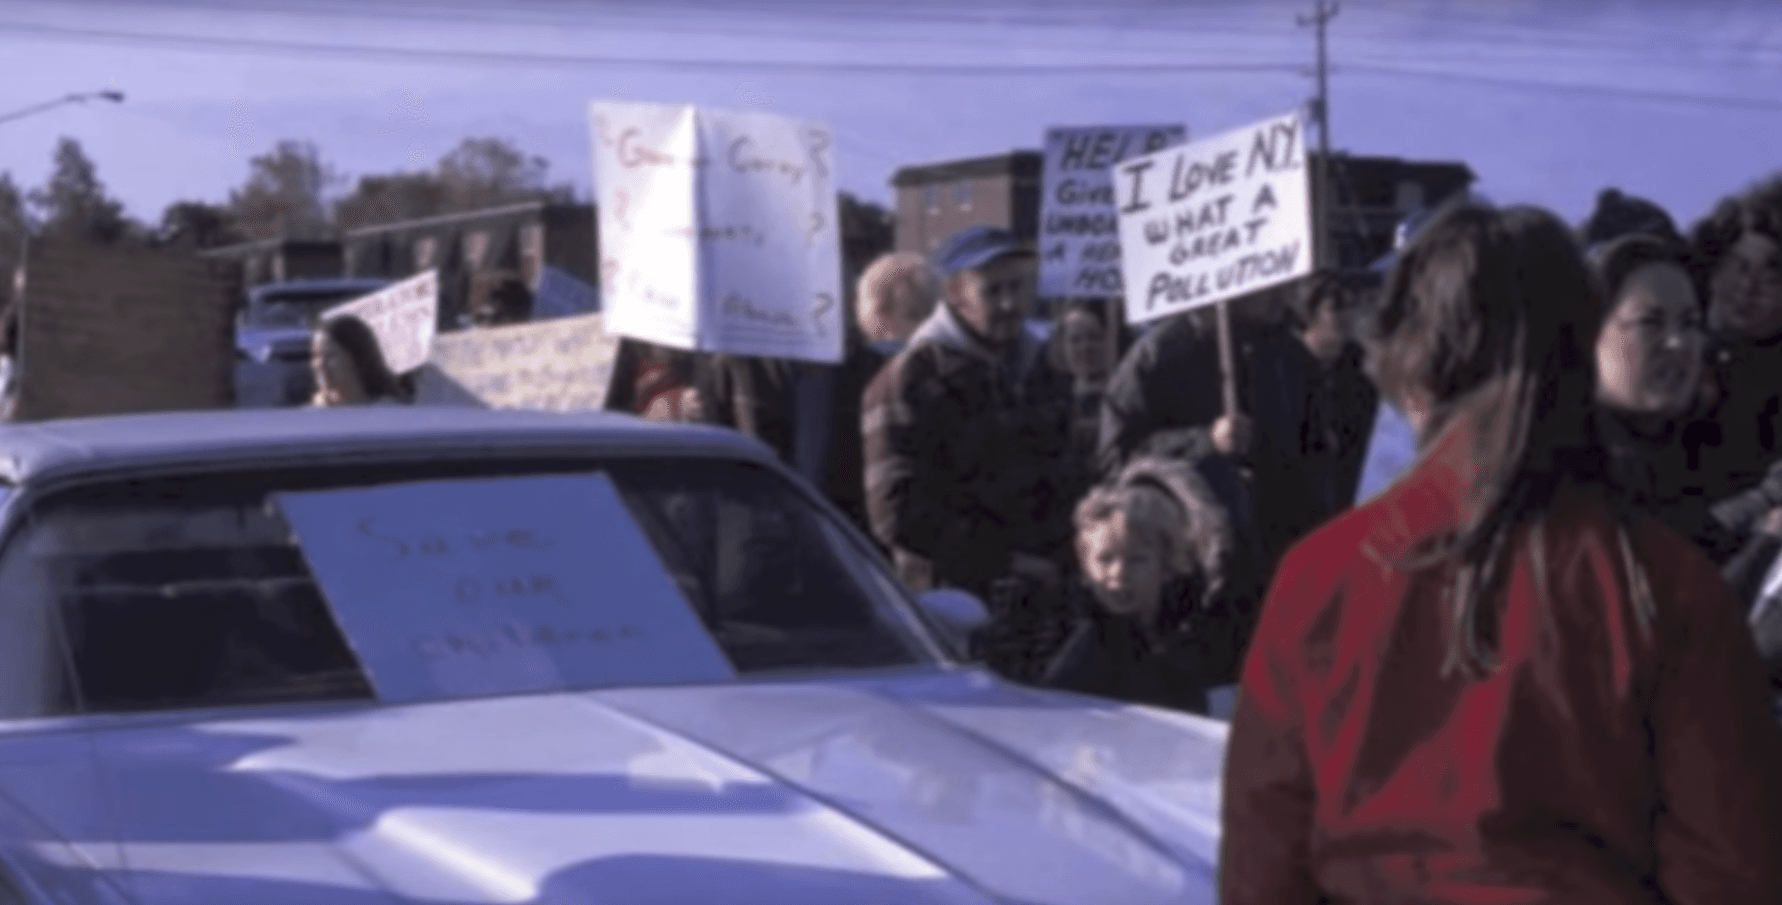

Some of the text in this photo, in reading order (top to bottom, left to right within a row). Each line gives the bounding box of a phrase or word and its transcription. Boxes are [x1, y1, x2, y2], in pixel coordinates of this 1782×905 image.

[1121, 160, 1154, 214] I
[1168, 149, 1238, 203] LOVE
[1143, 182, 1277, 246] WHAT A
[1168, 216, 1270, 266] GREAT
[1074, 267, 1122, 291] HO
[1146, 238, 1302, 312] POLLUTION
[357, 516, 555, 561] Save
